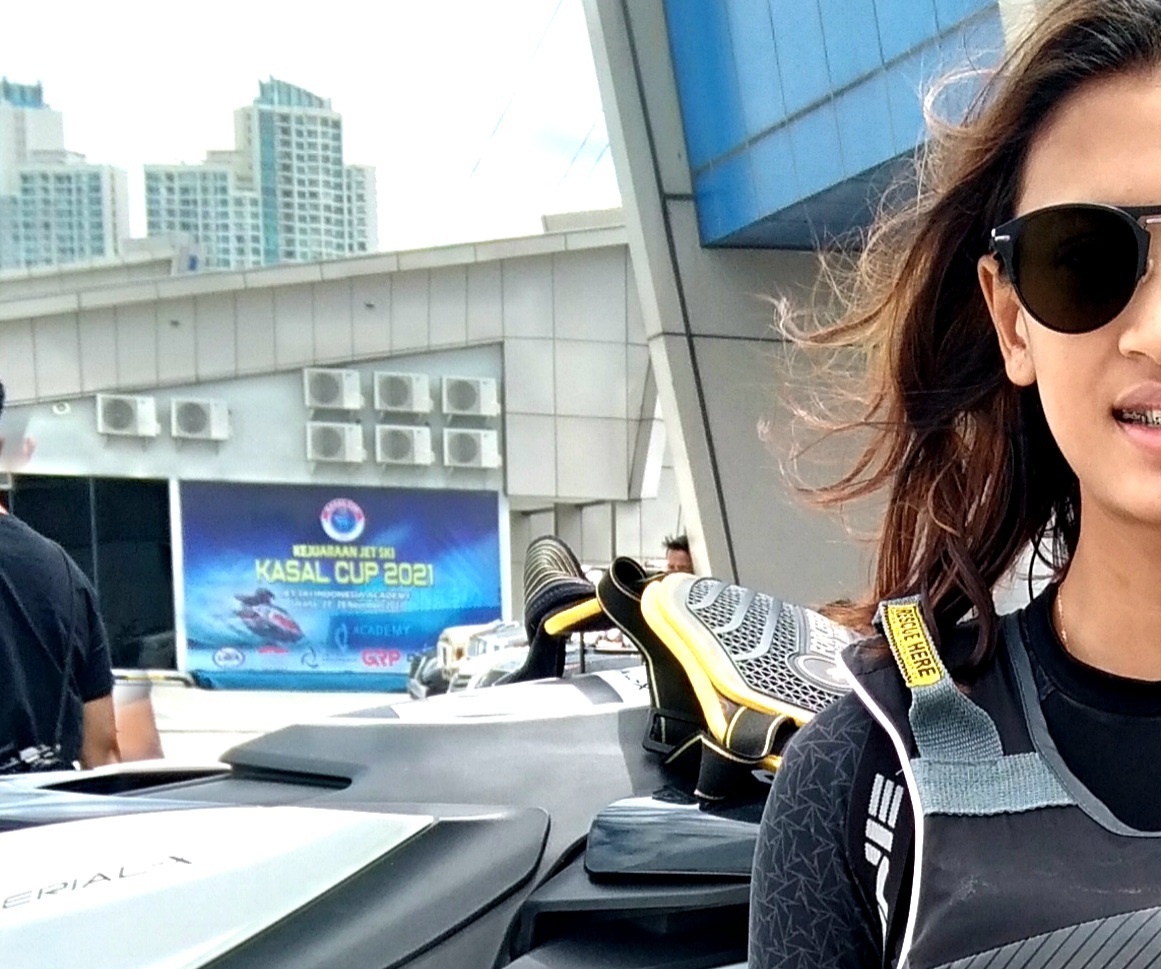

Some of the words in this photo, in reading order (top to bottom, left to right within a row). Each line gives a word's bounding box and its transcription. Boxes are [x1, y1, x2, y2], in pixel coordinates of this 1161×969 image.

[359, 545, 377, 559] JET
[255, 559, 331, 584] KASAL
[334, 560, 380, 585] CUP
[383, 562, 434, 587] 2021
[907, 641, 936, 678] HERE
